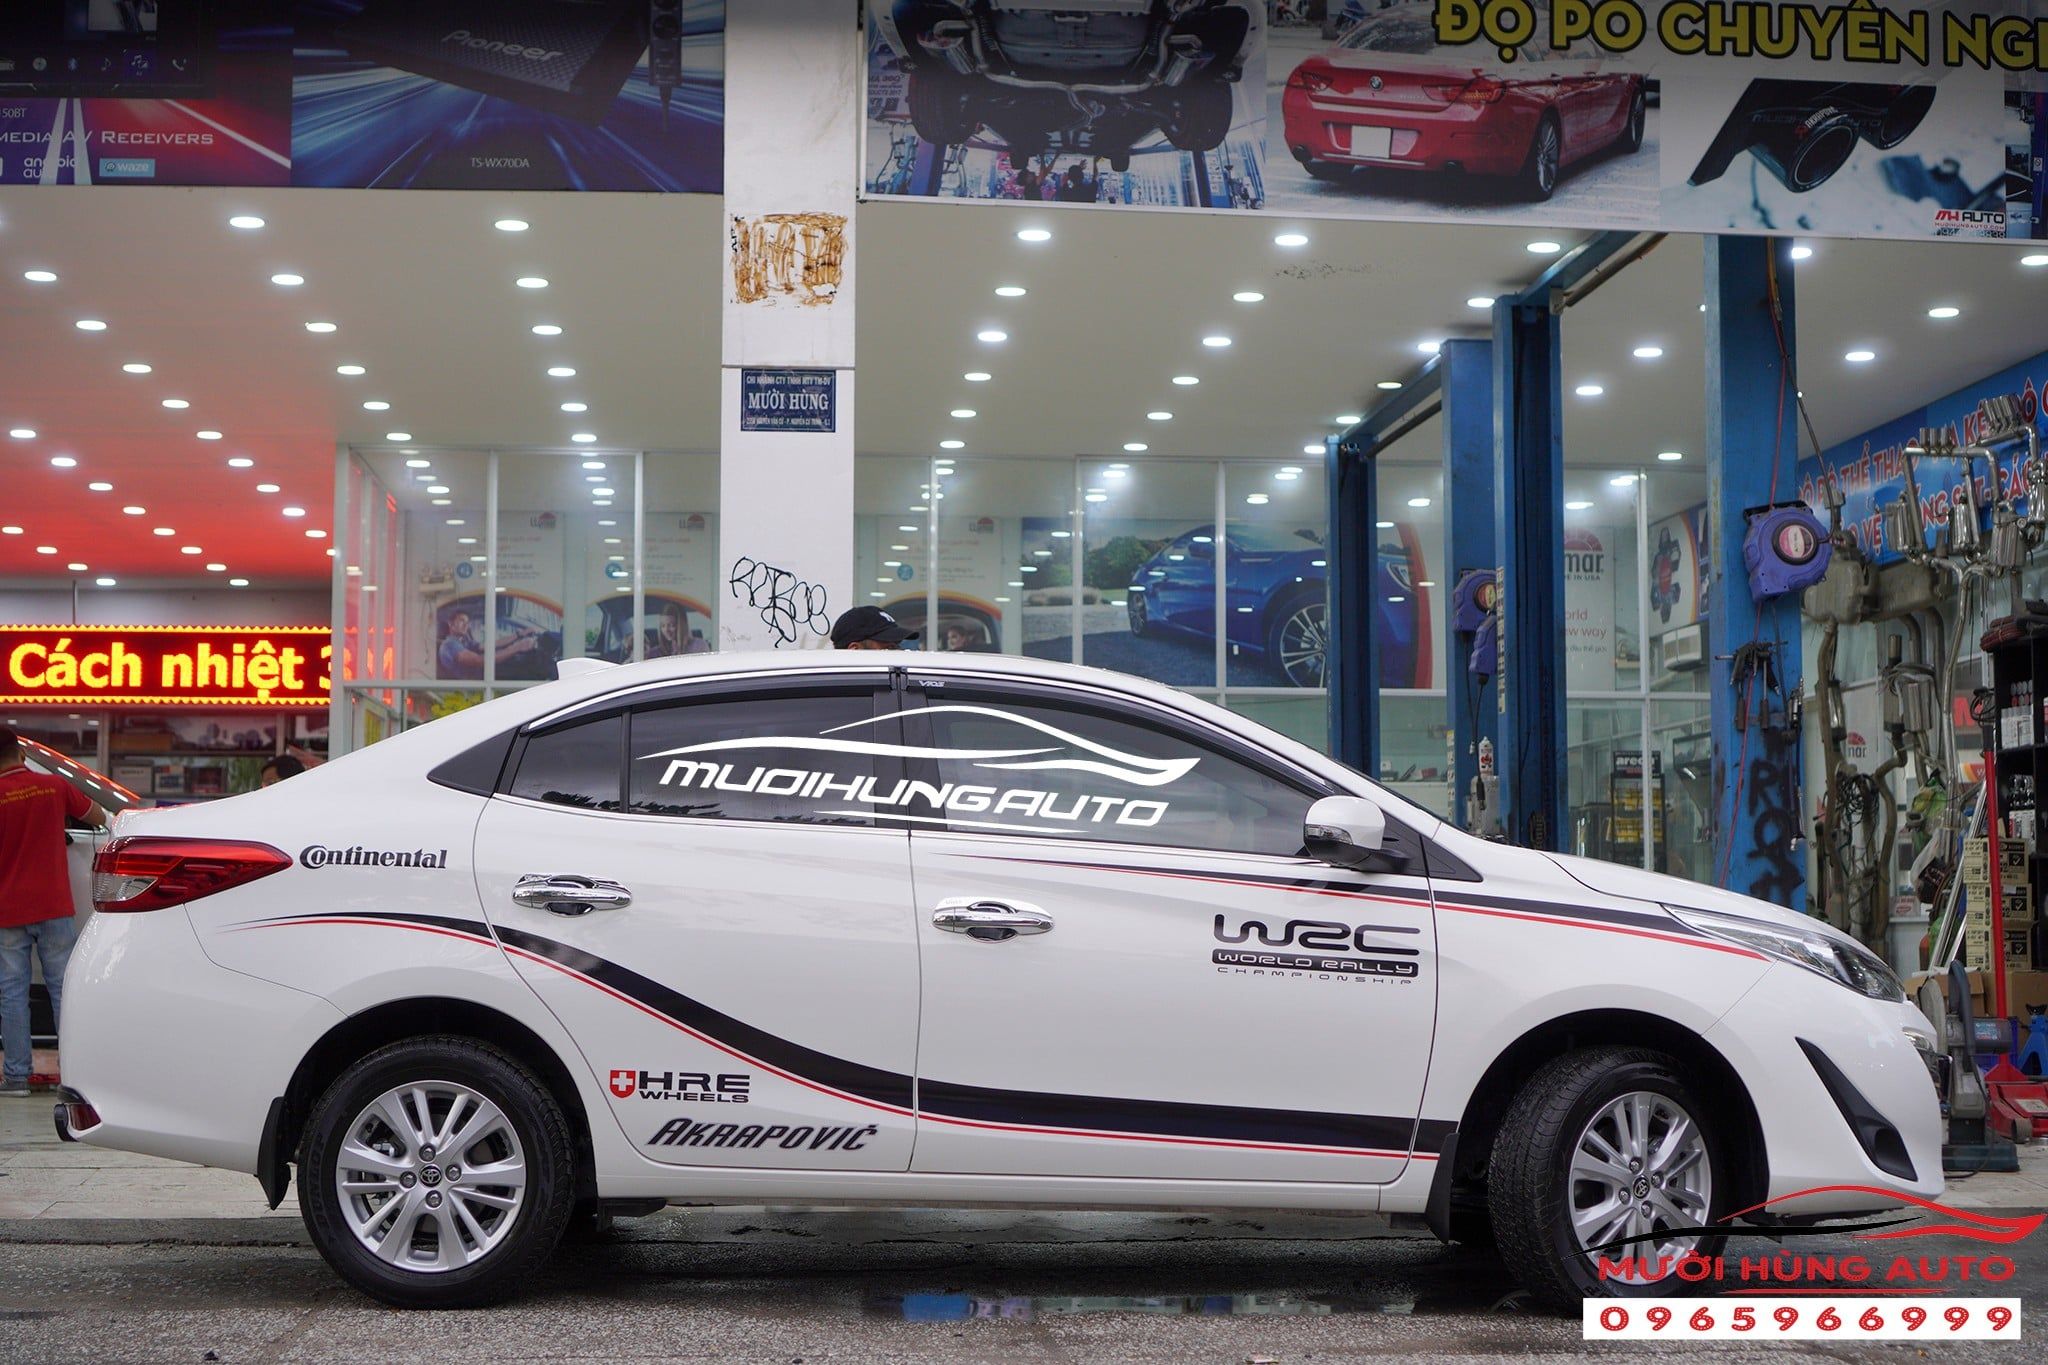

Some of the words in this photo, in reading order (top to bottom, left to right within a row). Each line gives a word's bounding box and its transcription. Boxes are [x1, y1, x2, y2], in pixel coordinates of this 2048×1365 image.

[1657, 0, 1930, 66] CHUYÊN
[442, 29, 564, 62] Pioneer
[118, 162, 149, 173] waze
[471, 158, 530, 168] TS-WX70DA
[1962, 211, 2004, 224] AUTO
[748, 388, 785, 409] MƯỜI
[789, 388, 829, 410] HÙNG
[9, 638, 143, 689] Cách
[161, 640, 305, 700] nhiệt
[918, 680, 946, 688] VIOS
[660, 760, 1170, 827] MUOIHUNGAUTO
[299, 845, 448, 869] Continental
[1213, 913, 1421, 956] WRC
[1217, 952, 1313, 968] WORLD
[1321, 960, 1414, 974] RALLY
[1217, 966, 1412, 985] CHAMPIONSHIP
[639, 1071, 751, 1094] HRE
[639, 1091, 749, 1104] WHEELS
